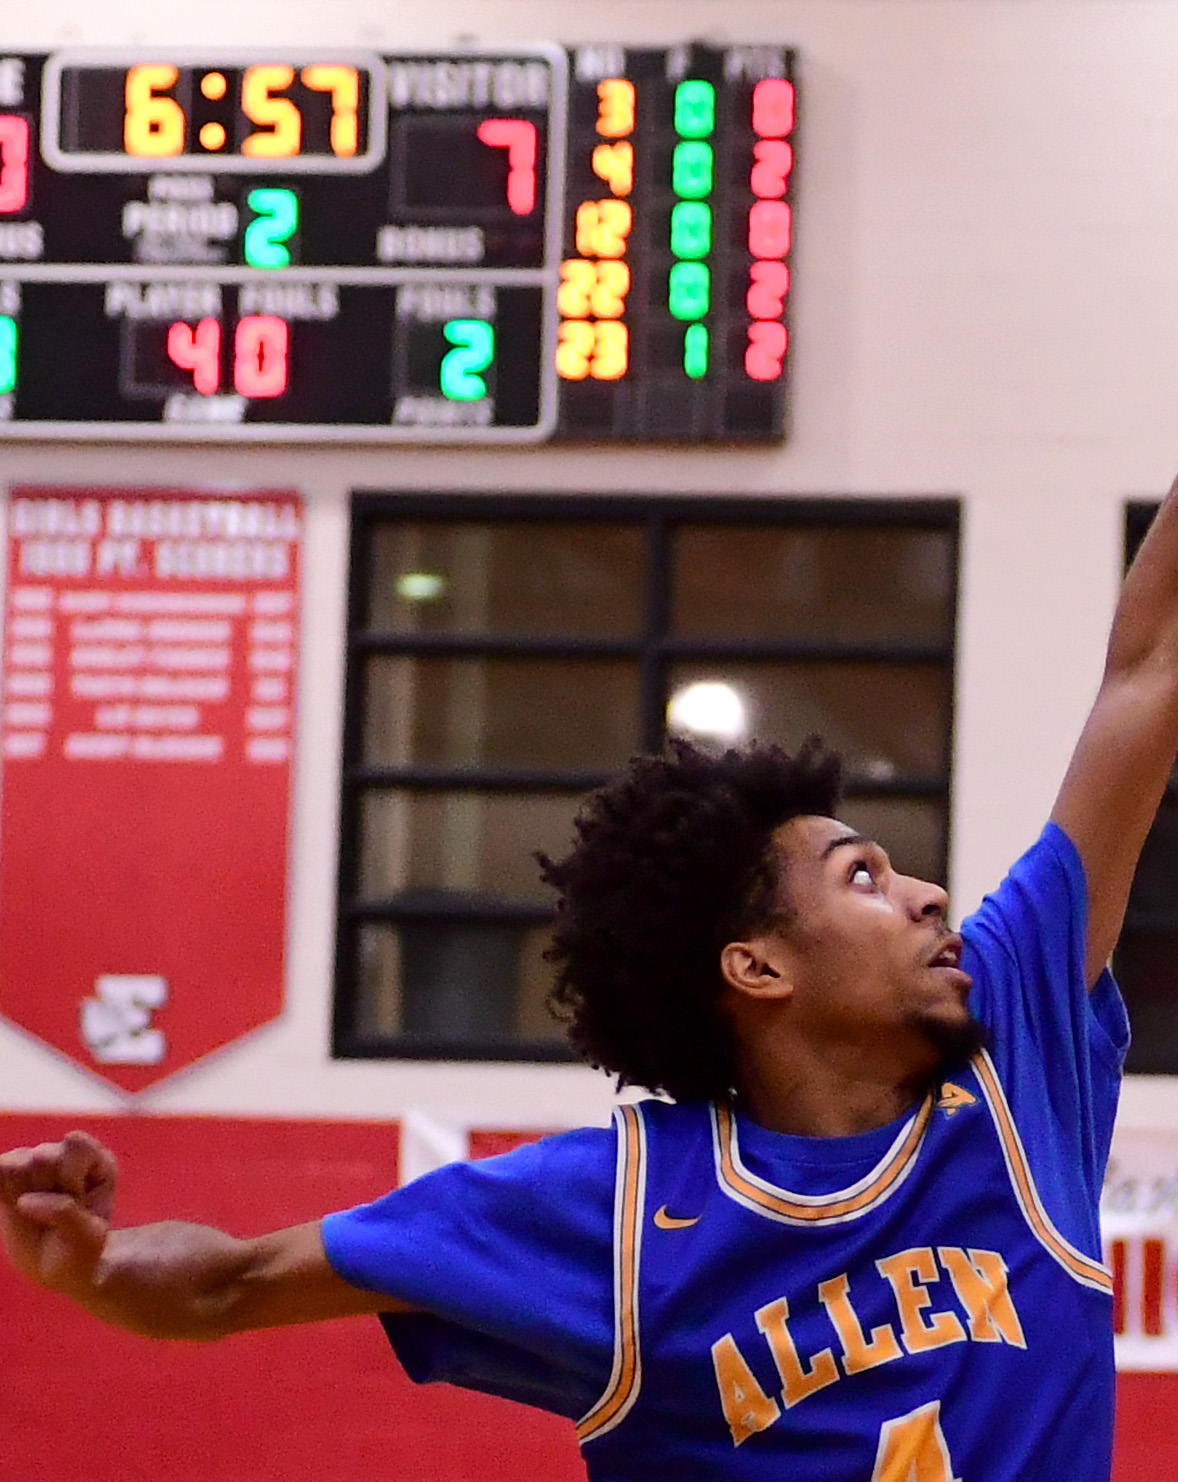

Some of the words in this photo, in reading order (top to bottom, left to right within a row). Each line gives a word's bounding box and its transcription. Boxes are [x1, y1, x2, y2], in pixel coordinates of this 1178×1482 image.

[125, 63, 359, 159] 6:57
[596, 78, 635, 138] 3
[477, 118, 536, 216] 7
[592, 141, 634, 196] 4
[751, 140, 792, 199] 2
[245, 188, 298, 270] 2
[557, 259, 630, 319] 22
[747, 259, 789, 319] 2
[168, 314, 288, 398] 40
[440, 318, 494, 401] 2
[555, 319, 629, 381] 23
[684, 323, 709, 379] 1
[744, 320, 787, 381] 2
[710, 1246, 1028, 1448] ALLEN
